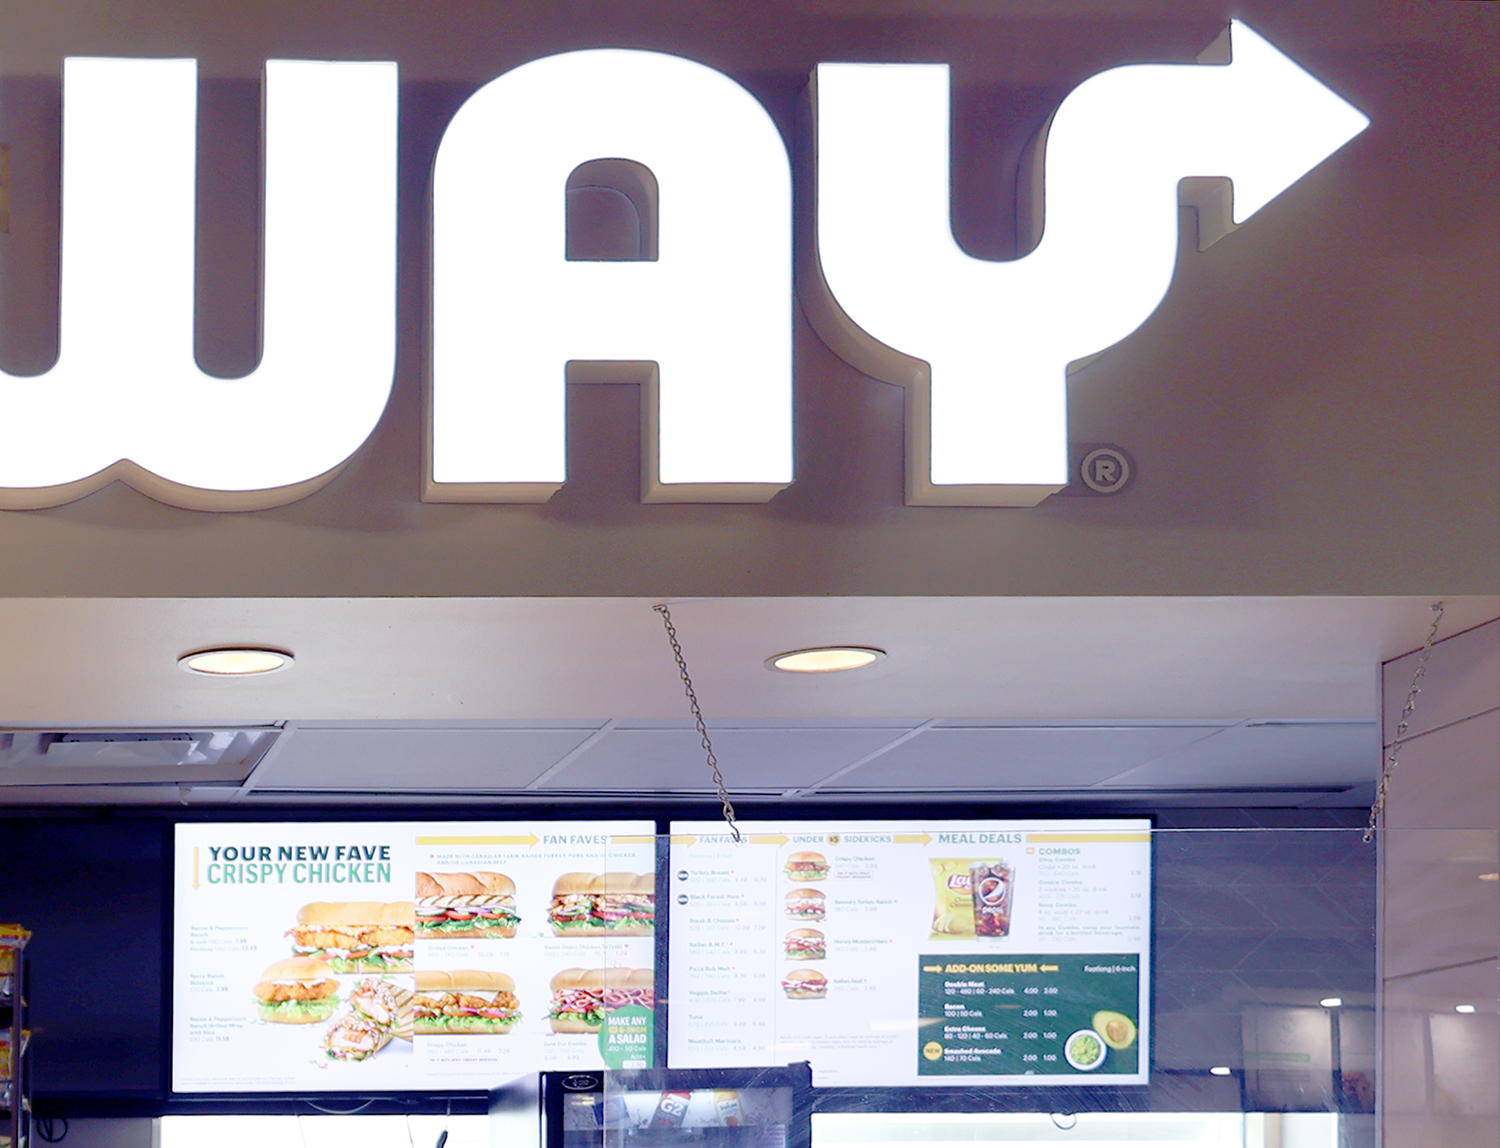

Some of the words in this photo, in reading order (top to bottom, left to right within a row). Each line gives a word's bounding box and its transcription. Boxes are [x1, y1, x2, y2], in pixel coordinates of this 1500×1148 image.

[543, 835, 567, 844] FAN
[570, 835, 607, 844] FAVES
[844, 835, 891, 843] SIDEKICKS
[939, 834, 976, 844] MEAL
[979, 834, 1022, 844] DEALS
[208, 846, 271, 861] YOUR
[278, 846, 329, 861] NEW
[335, 846, 390, 860] FAVE
[1038, 847, 1081, 855] COMBOS
[207, 863, 287, 884] CRISPY
[293, 863, 391, 883] CHICKEN
[945, 964, 985, 973] ADD-ON
[986, 964, 1013, 973] SOME
[1014, 964, 1037, 972] YUM
[608, 1017, 630, 1025] MAKE
[631, 1017, 647, 1025] ANY
[609, 1034, 616, 1043] A
[617, 1034, 647, 1044] SALAD
[660, 1098, 684, 1116] G2
